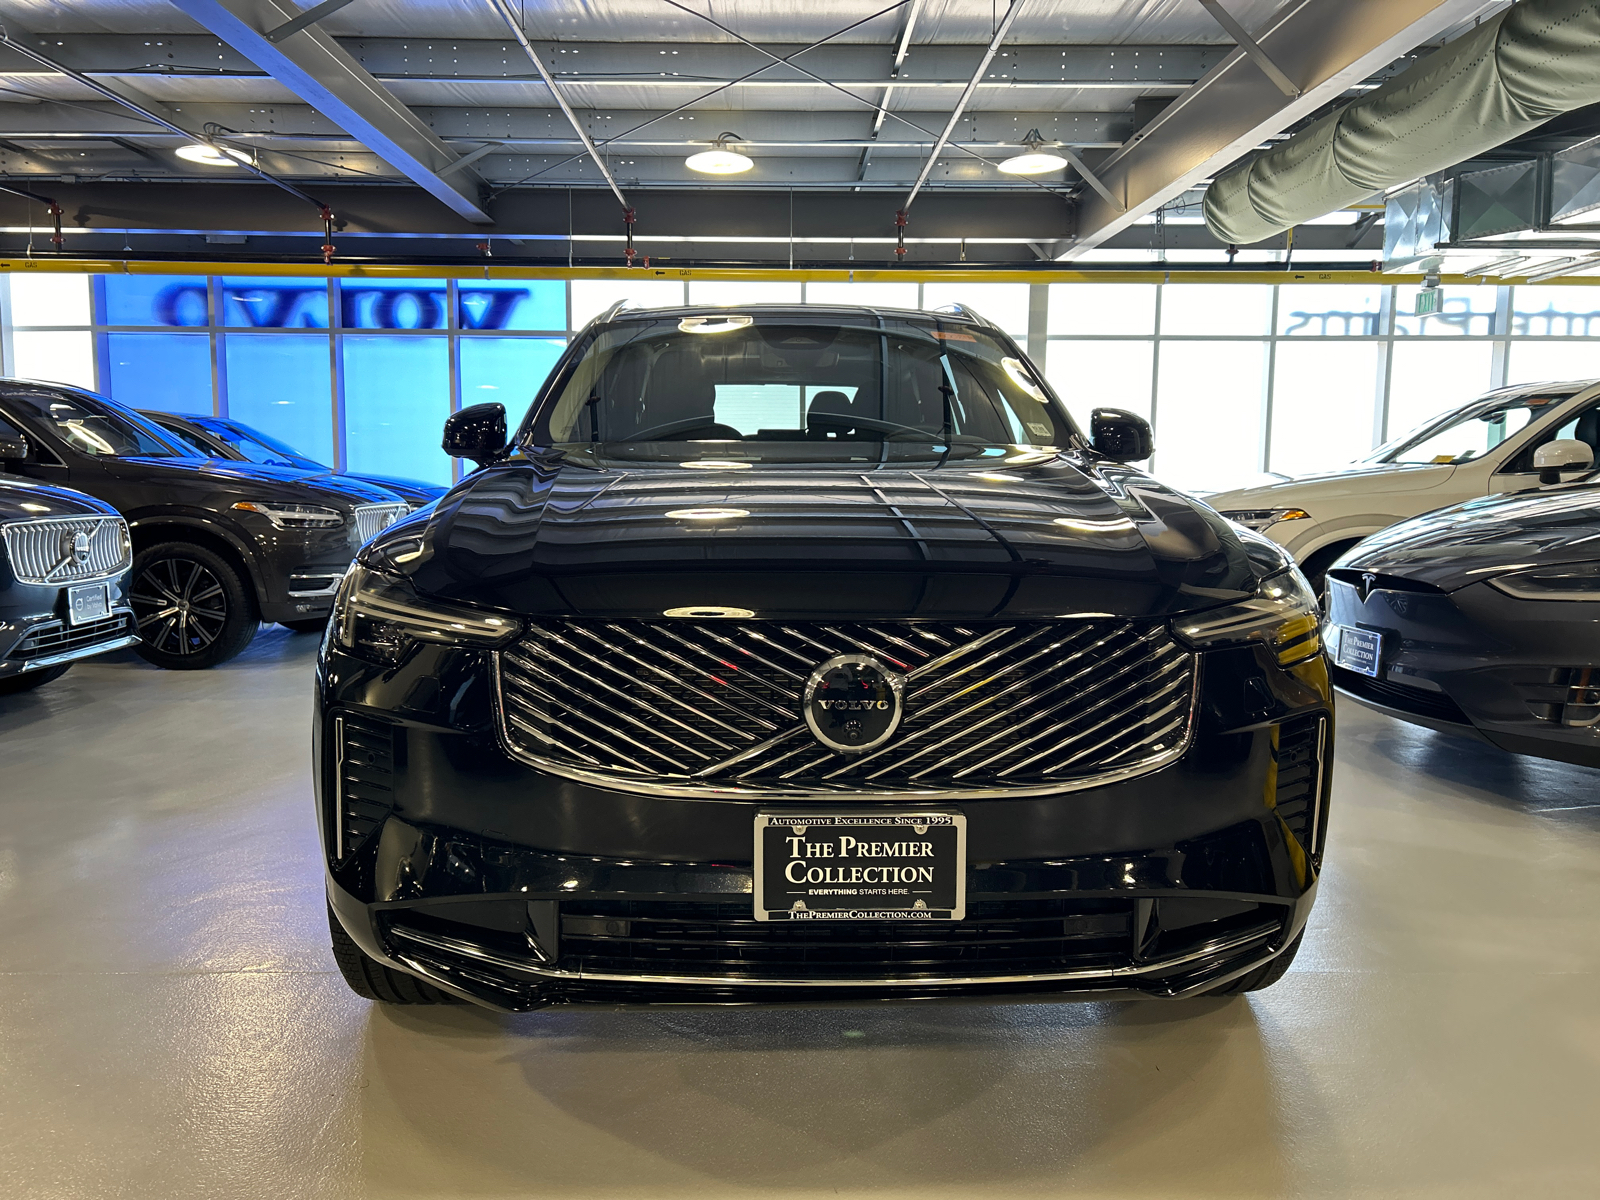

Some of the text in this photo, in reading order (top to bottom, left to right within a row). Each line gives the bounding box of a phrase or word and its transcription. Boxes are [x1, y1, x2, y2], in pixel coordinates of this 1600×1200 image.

[1418, 290, 1435, 313] EXIT
[1353, 636, 1374, 650] PREMIER
[1343, 644, 1374, 660] COLLECTION
[818, 700, 889, 710] VOLVO
[770, 817, 951, 825] AUTOMOTIVE EXCELLENCE SINCE 1995
[785, 836, 935, 858] THE PREMIER
[785, 860, 934, 884] COLLECTION
[788, 911, 932, 919] THEPREMIERCOLLECTION.COM
